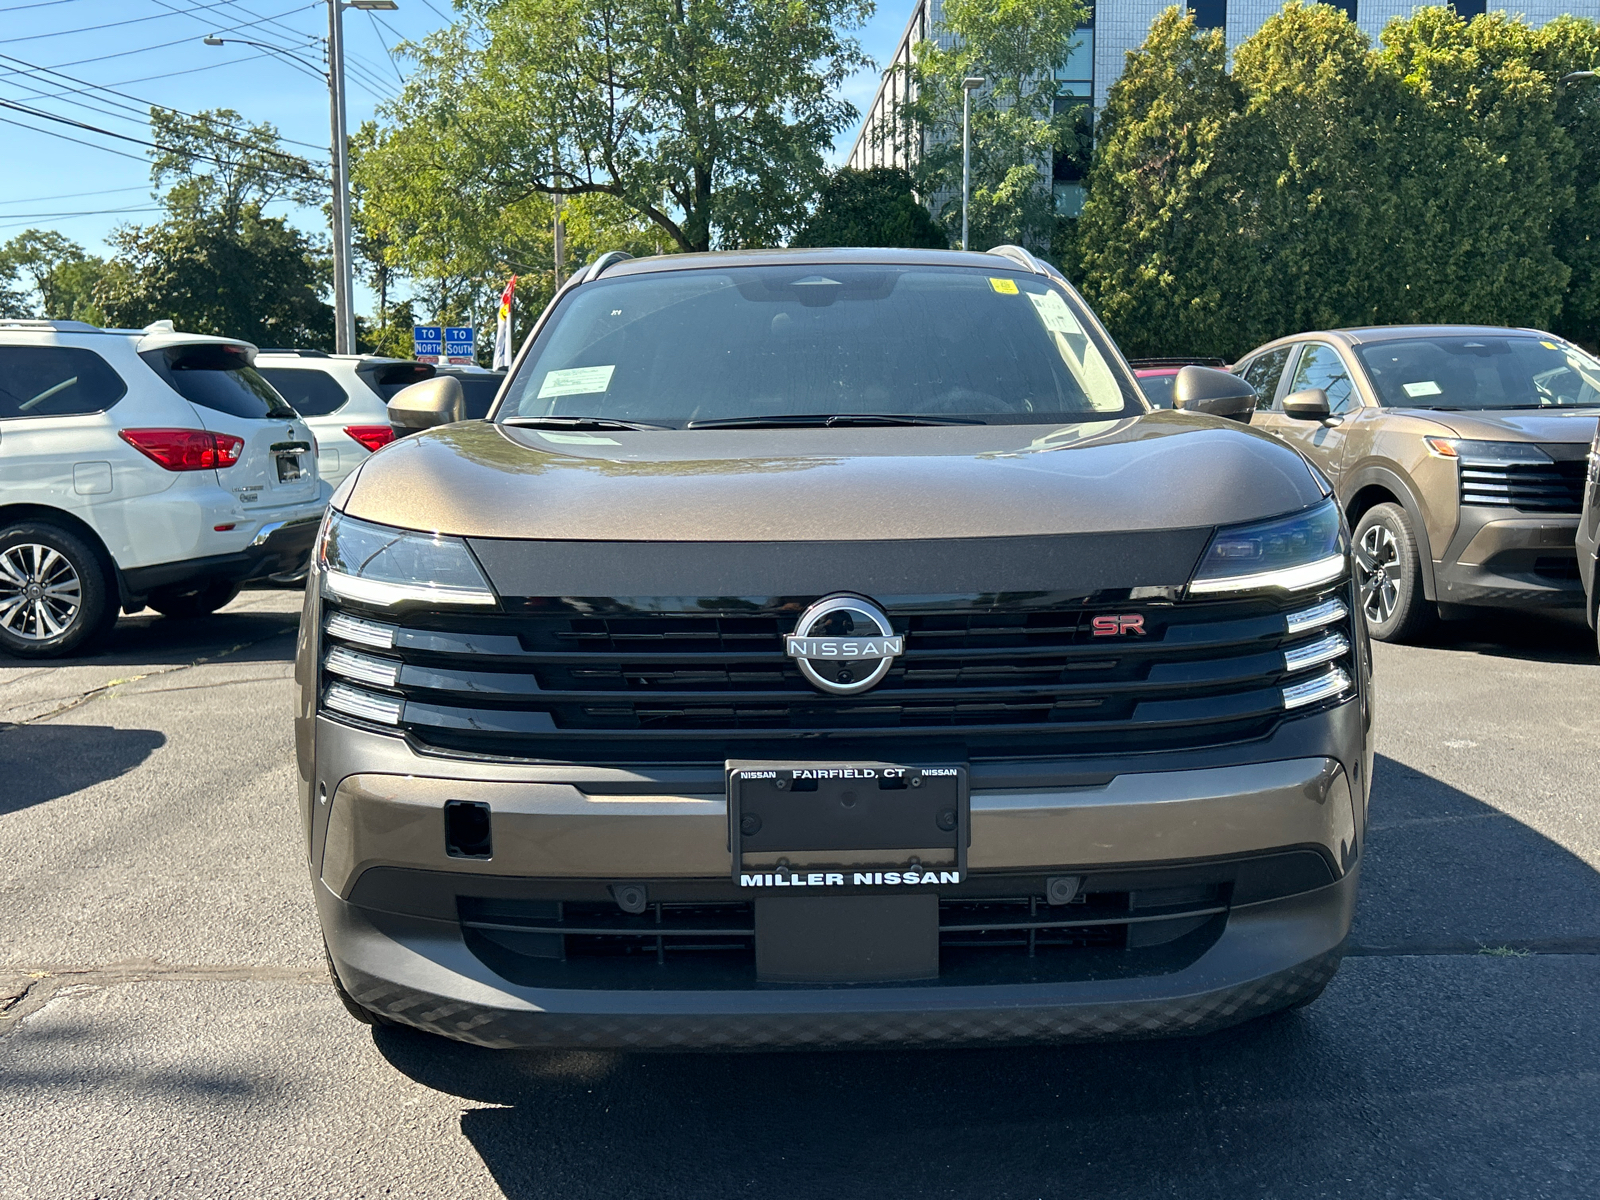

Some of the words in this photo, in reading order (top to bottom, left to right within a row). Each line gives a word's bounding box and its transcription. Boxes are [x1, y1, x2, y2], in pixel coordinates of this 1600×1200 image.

[421, 329, 435, 338] TO
[452, 330, 466, 339] TO
[416, 343, 441, 353] NORTH
[447, 344, 473, 354] SOUTH
[1092, 614, 1146, 636] SR
[790, 640, 900, 656] NISSAN
[740, 771, 776, 779] NISSAN
[792, 769, 879, 779] FAIRFIELD,
[882, 769, 905, 778] CT
[740, 873, 844, 887] MILLER
[853, 872, 960, 885] NISSAN
